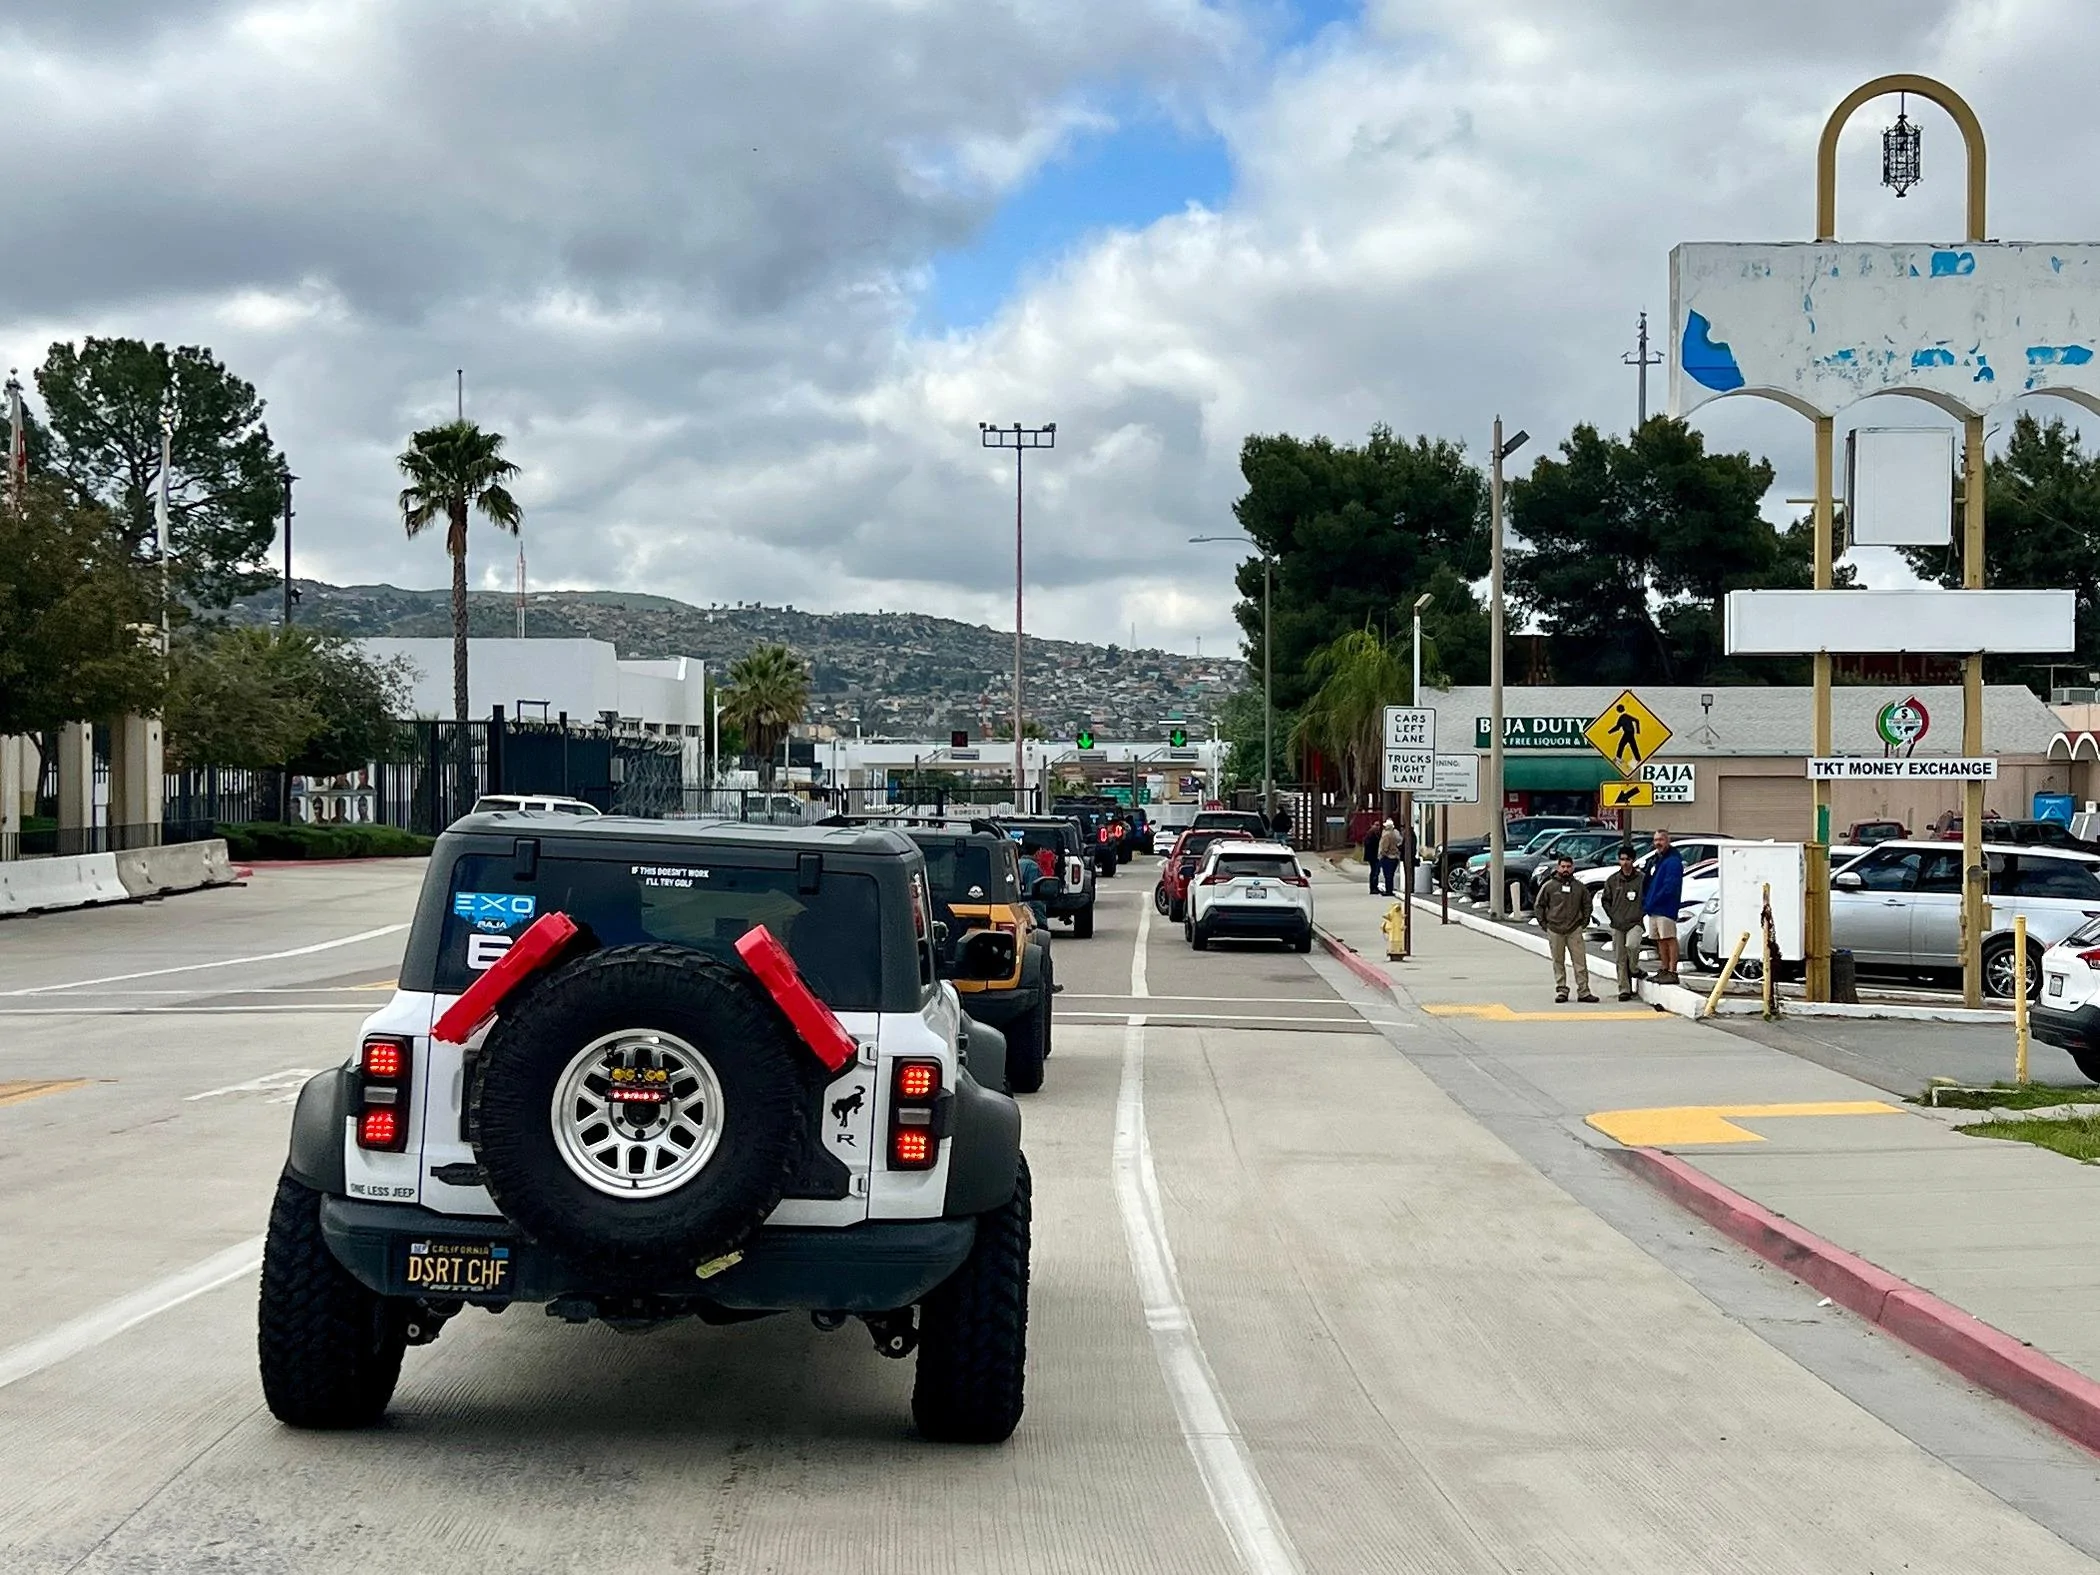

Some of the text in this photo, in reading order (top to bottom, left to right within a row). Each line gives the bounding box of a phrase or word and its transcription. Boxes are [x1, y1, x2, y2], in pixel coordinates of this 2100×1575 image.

[1394, 714, 1426, 723] CARS
[1396, 725, 1424, 733] LEFT
[1480, 718, 1588, 736] BJA DUTY
[1395, 734, 1425, 743] LANE
[1510, 737, 1531, 746] FREE
[1533, 737, 1571, 746] LIQUOR
[1388, 754, 1431, 763] TRUCKS
[1392, 764, 1426, 773] RIGHT
[1814, 762, 1992, 775] TKT MONEY EXCHANGE
[1393, 774, 1424, 783] LANE
[1642, 765, 1693, 783] BAJA
[631, 866, 639, 875] IF
[640, 867, 657, 875] THIS
[688, 869, 710, 878] WORK
[645, 878, 694, 888] I'LL TRY GOLF
[455, 894, 534, 914] EXO
[476, 920, 508, 929] BAJA
[836, 1133, 857, 1148] R
[350, 1183, 416, 1198] ONE LESS JEEP
[431, 1244, 489, 1255] CALIFORNIA
[407, 1256, 509, 1286] DSRT CHF
